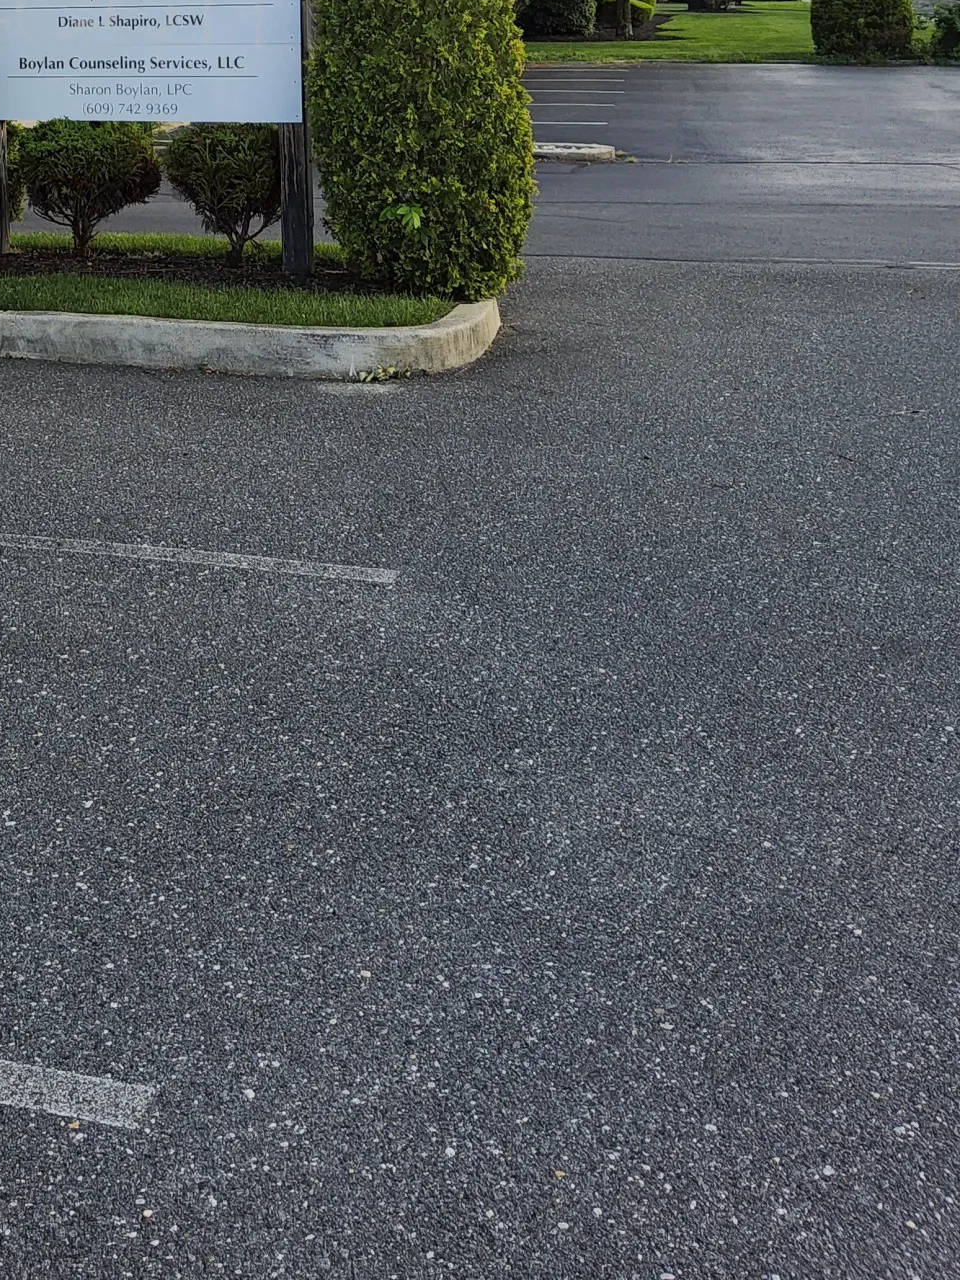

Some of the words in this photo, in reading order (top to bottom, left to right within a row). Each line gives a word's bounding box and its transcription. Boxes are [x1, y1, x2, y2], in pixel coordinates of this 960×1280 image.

[58, 16, 94, 28] Diane
[98, 15, 105, 27] L
[109, 14, 161, 31] Shapiro,
[165, 14, 204, 26] LCSW
[19, 56, 64, 73] Boylan
[69, 56, 145, 73] Counseling
[150, 56, 212, 71] Services,
[217, 56, 245, 69] LLC
[69, 83, 111, 96] Sharon
[116, 83, 162, 98] Boylan,
[167, 82, 192, 96] LPC
[82, 102, 113, 115] (609)
[118, 102, 141, 115] 742
[146, 102, 178, 115] 9369
